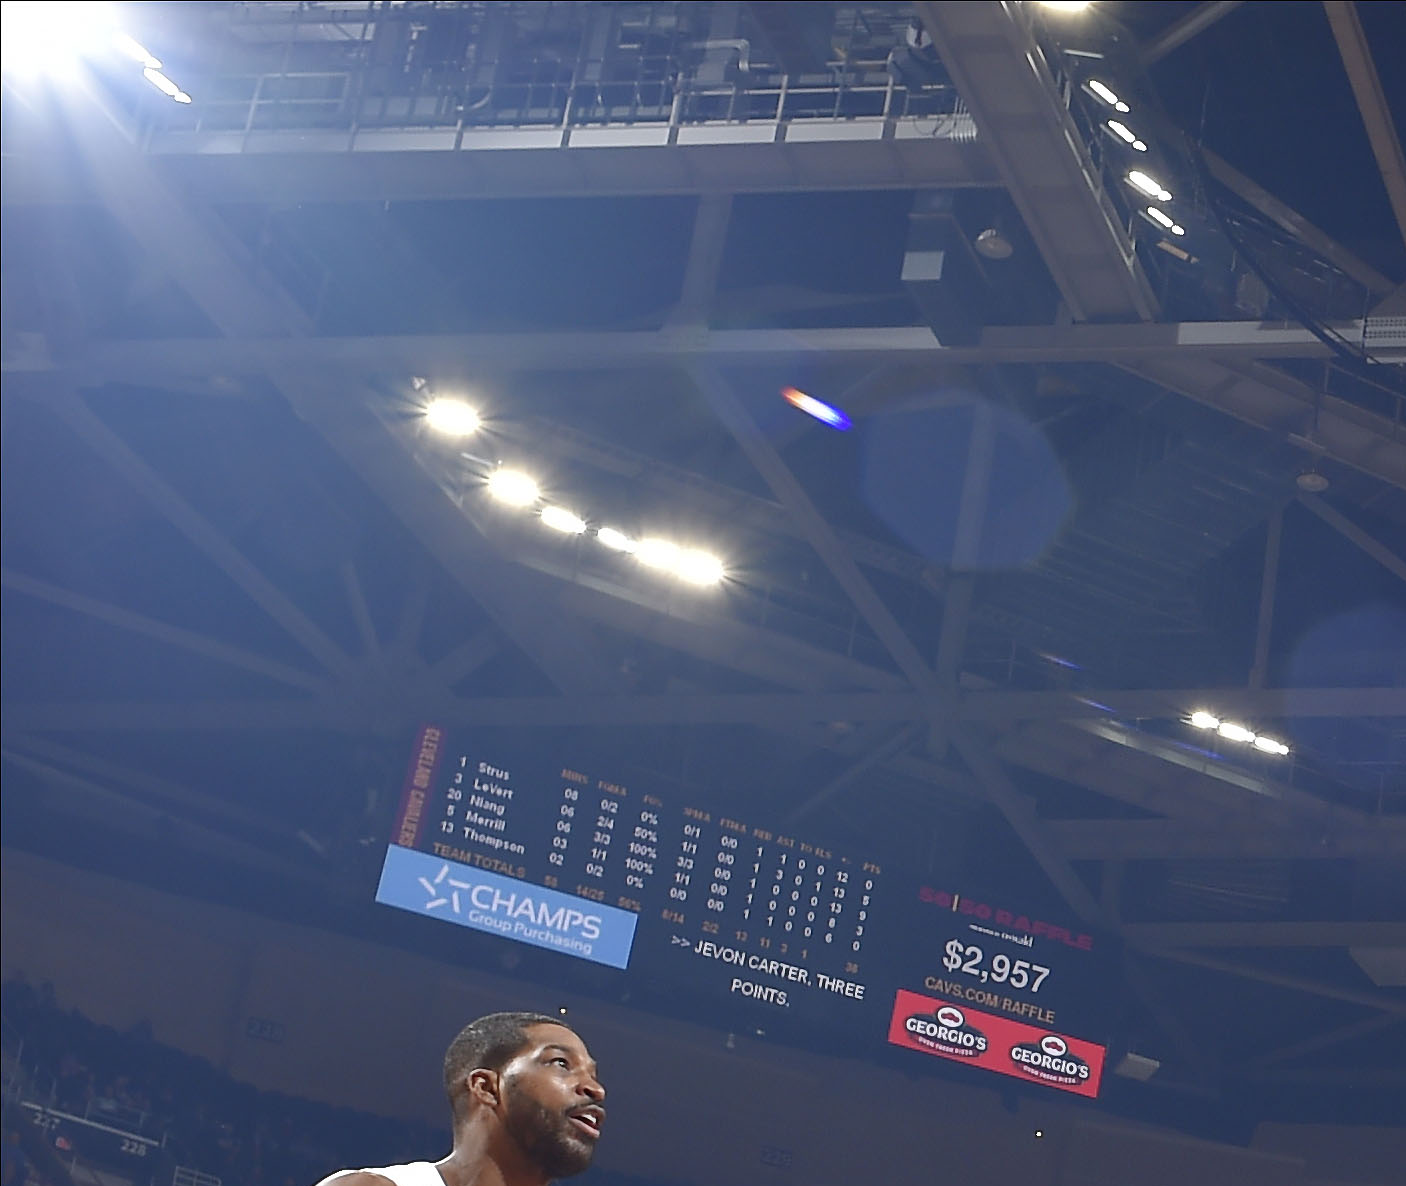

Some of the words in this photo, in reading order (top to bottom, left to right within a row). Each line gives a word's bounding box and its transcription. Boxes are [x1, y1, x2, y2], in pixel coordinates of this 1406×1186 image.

[479, 762, 509, 780] Strus
[474, 778, 514, 799] LeVert
[466, 811, 506, 831] Merrill
[470, 795, 505, 816] Niang
[464, 827, 525, 854] Thompson
[433, 842, 472, 864] TEAM
[473, 854, 526, 879] TOTALS
[470, 885, 601, 939] CHAMPS
[468, 910, 512, 932] Group
[513, 922, 592, 954] Purchasing
[695, 940, 746, 966] JEVON
[816, 973, 865, 1000] THREE
[942, 938, 1050, 993] $2,957
[731, 978, 790, 1007] POINTS.
[906, 1018, 987, 1051] GEORGIO'S
[1011, 1047, 1089, 1079] GEORGIO'S
